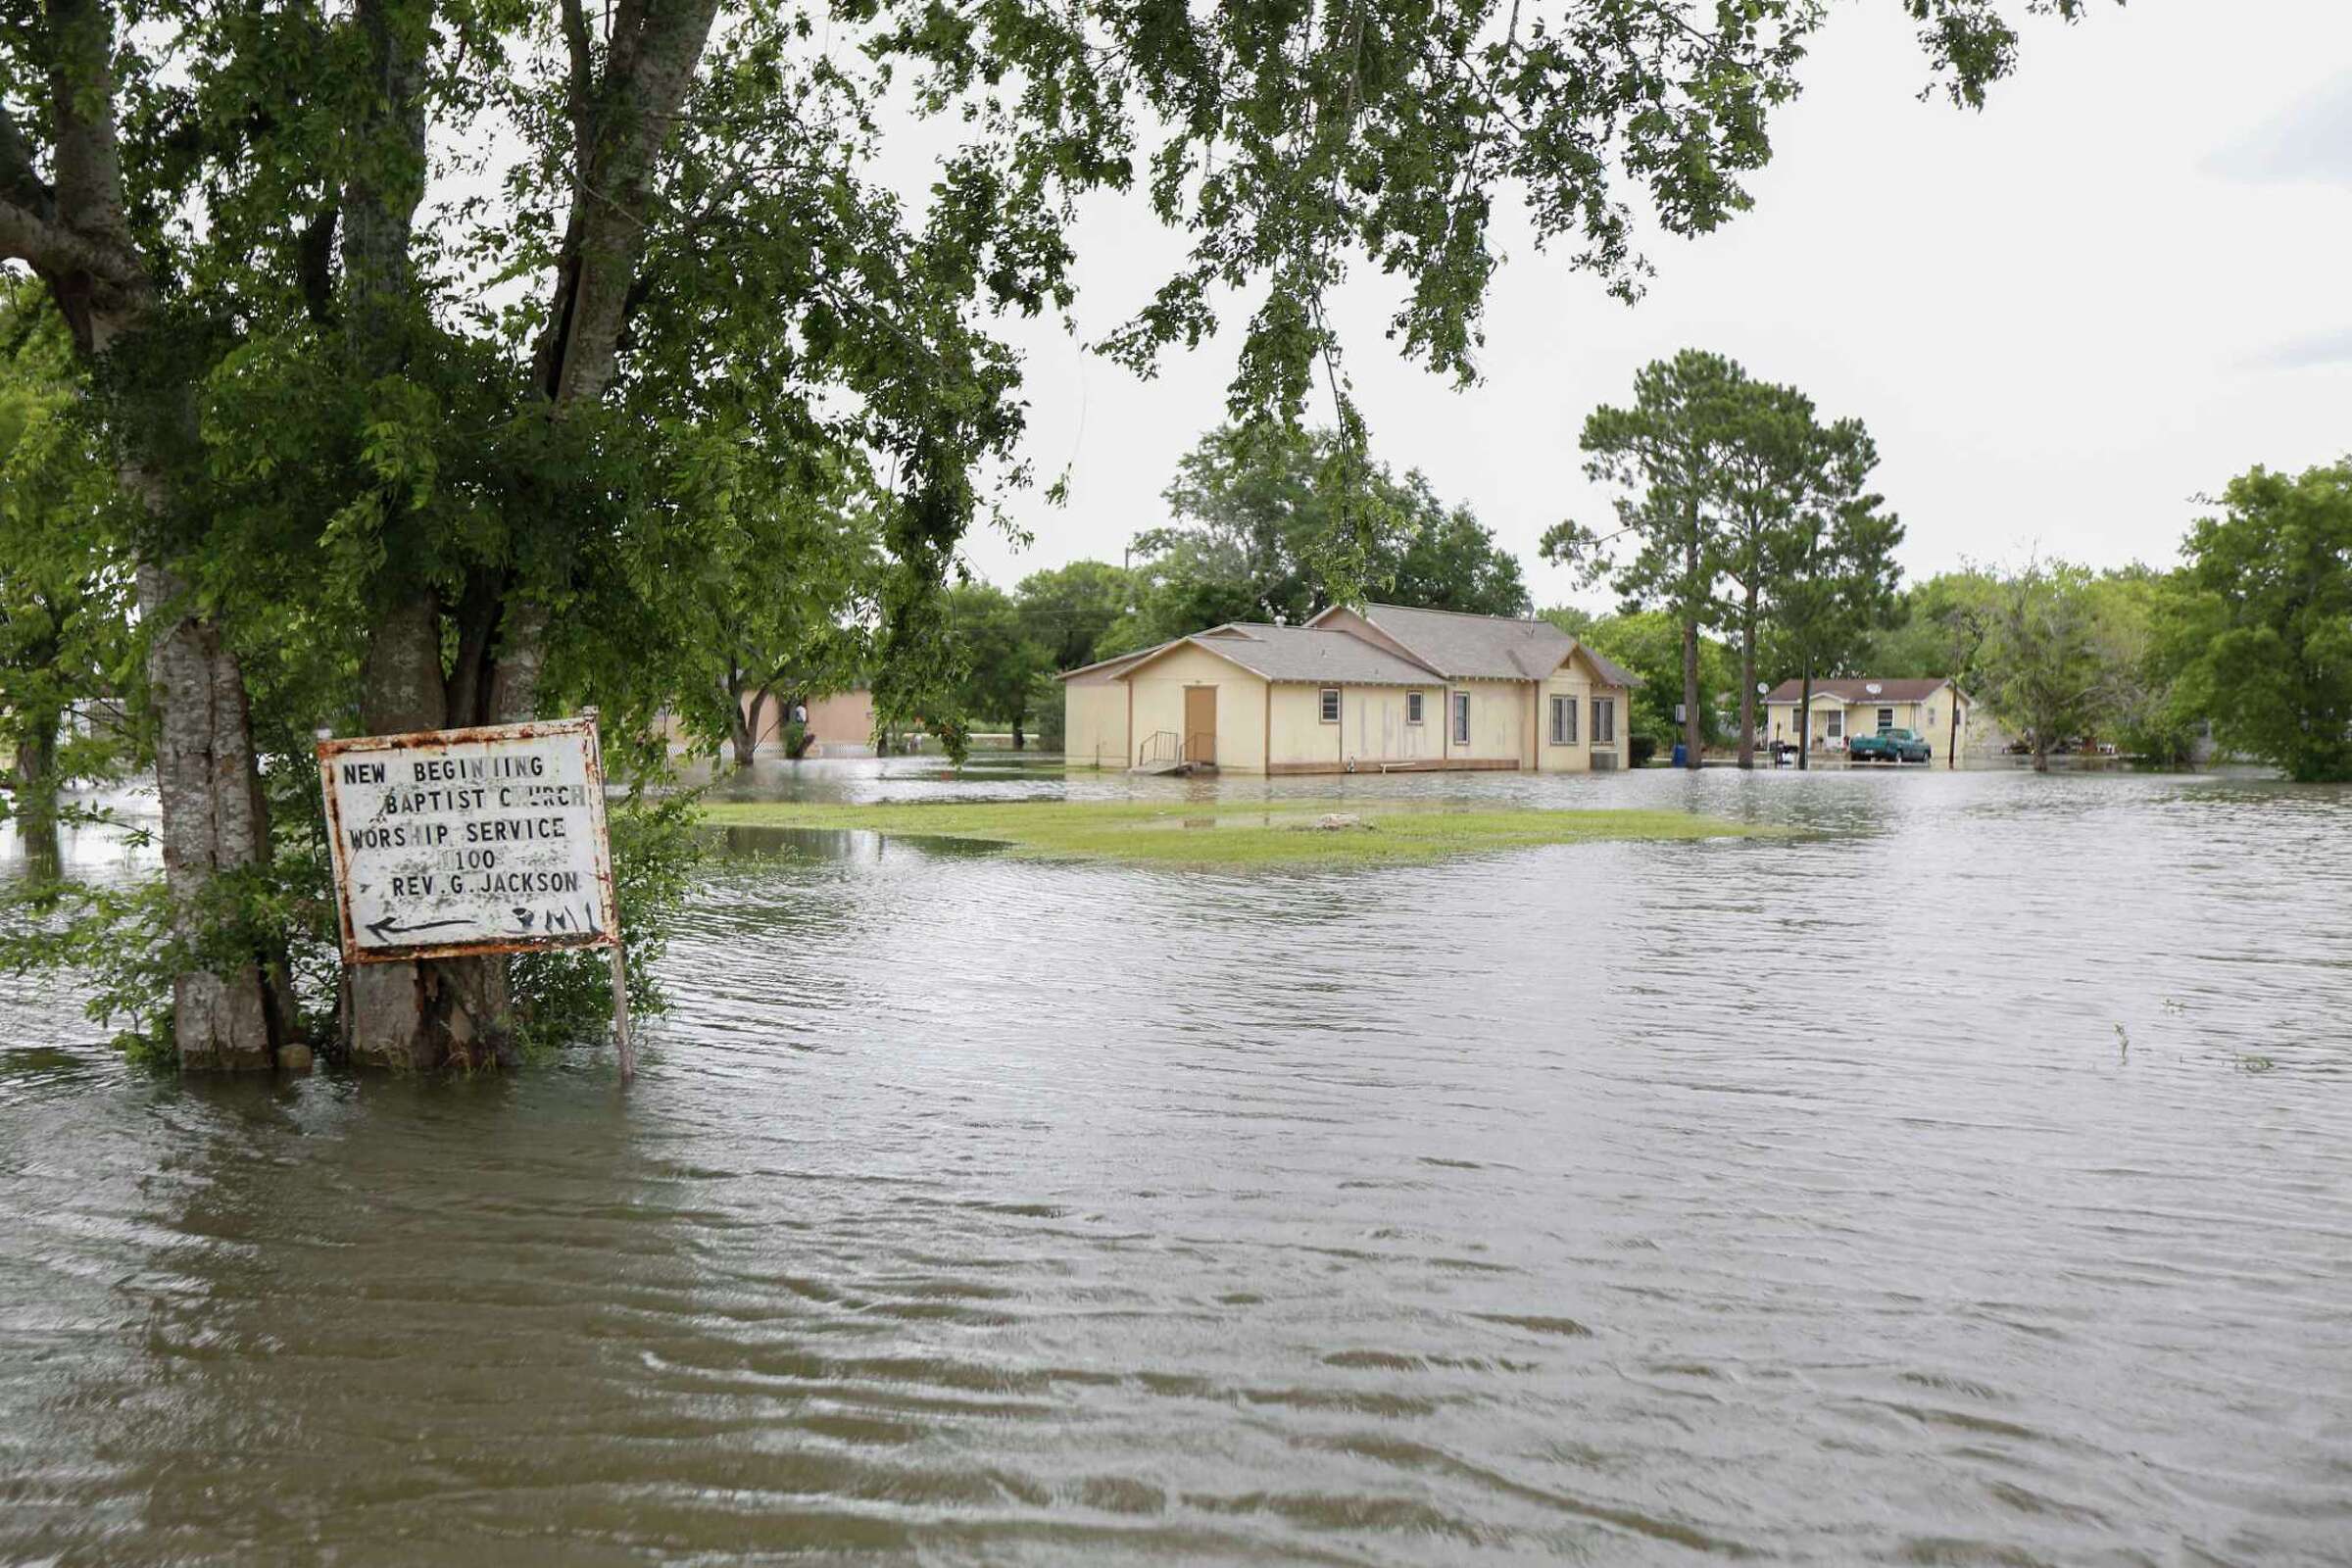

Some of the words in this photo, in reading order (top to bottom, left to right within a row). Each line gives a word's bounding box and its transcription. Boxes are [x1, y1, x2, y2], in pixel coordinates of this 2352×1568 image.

[344, 763, 386, 785] NEW
[386, 788, 485, 814] BAPTIST
[500, 784, 585, 808] CURCH
[350, 825, 448, 849] WORSHIP
[466, 817, 566, 842] SERVICE
